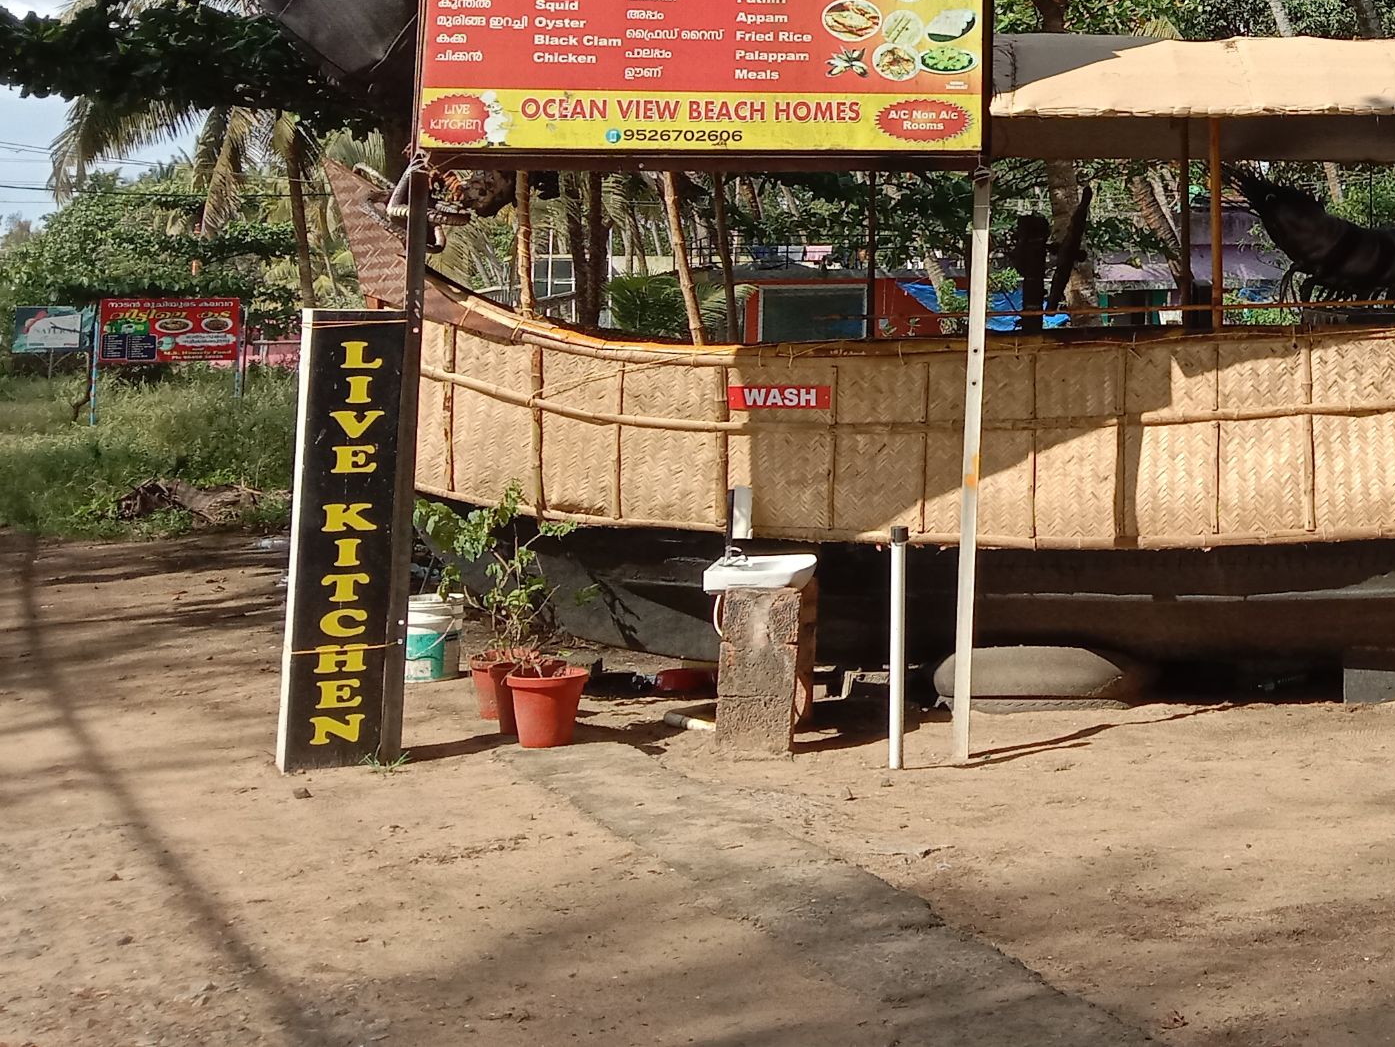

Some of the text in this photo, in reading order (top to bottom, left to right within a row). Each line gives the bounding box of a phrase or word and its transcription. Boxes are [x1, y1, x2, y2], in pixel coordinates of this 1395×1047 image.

[535, 0, 579, 12] Squid
[535, 17, 586, 29] Oyster
[736, 12, 788, 24] Appam
[436, 34, 467, 43] കക്ക
[534, 34, 621, 46] Black Clam
[736, 31, 812, 42] Fried Rice
[435, 50, 483, 62] ചിക്കൻ
[533, 53, 596, 64] Chicken
[735, 50, 809, 62] Palappam
[624, 66, 663, 79] ഊണ്
[735, 69, 779, 80] Meals
[444, 104, 470, 115] LIVE
[521, 98, 861, 123] OCEAN VIEW BEACH HOMES
[888, 109, 909, 120] A/C
[912, 110, 936, 120] Non
[903, 120, 944, 130] Rooms
[623, 129, 743, 143] 9526702606
[744, 389, 816, 406] WASH
[329, 341, 385, 474] LIVE
[309, 503, 378, 746] KITCHEN
